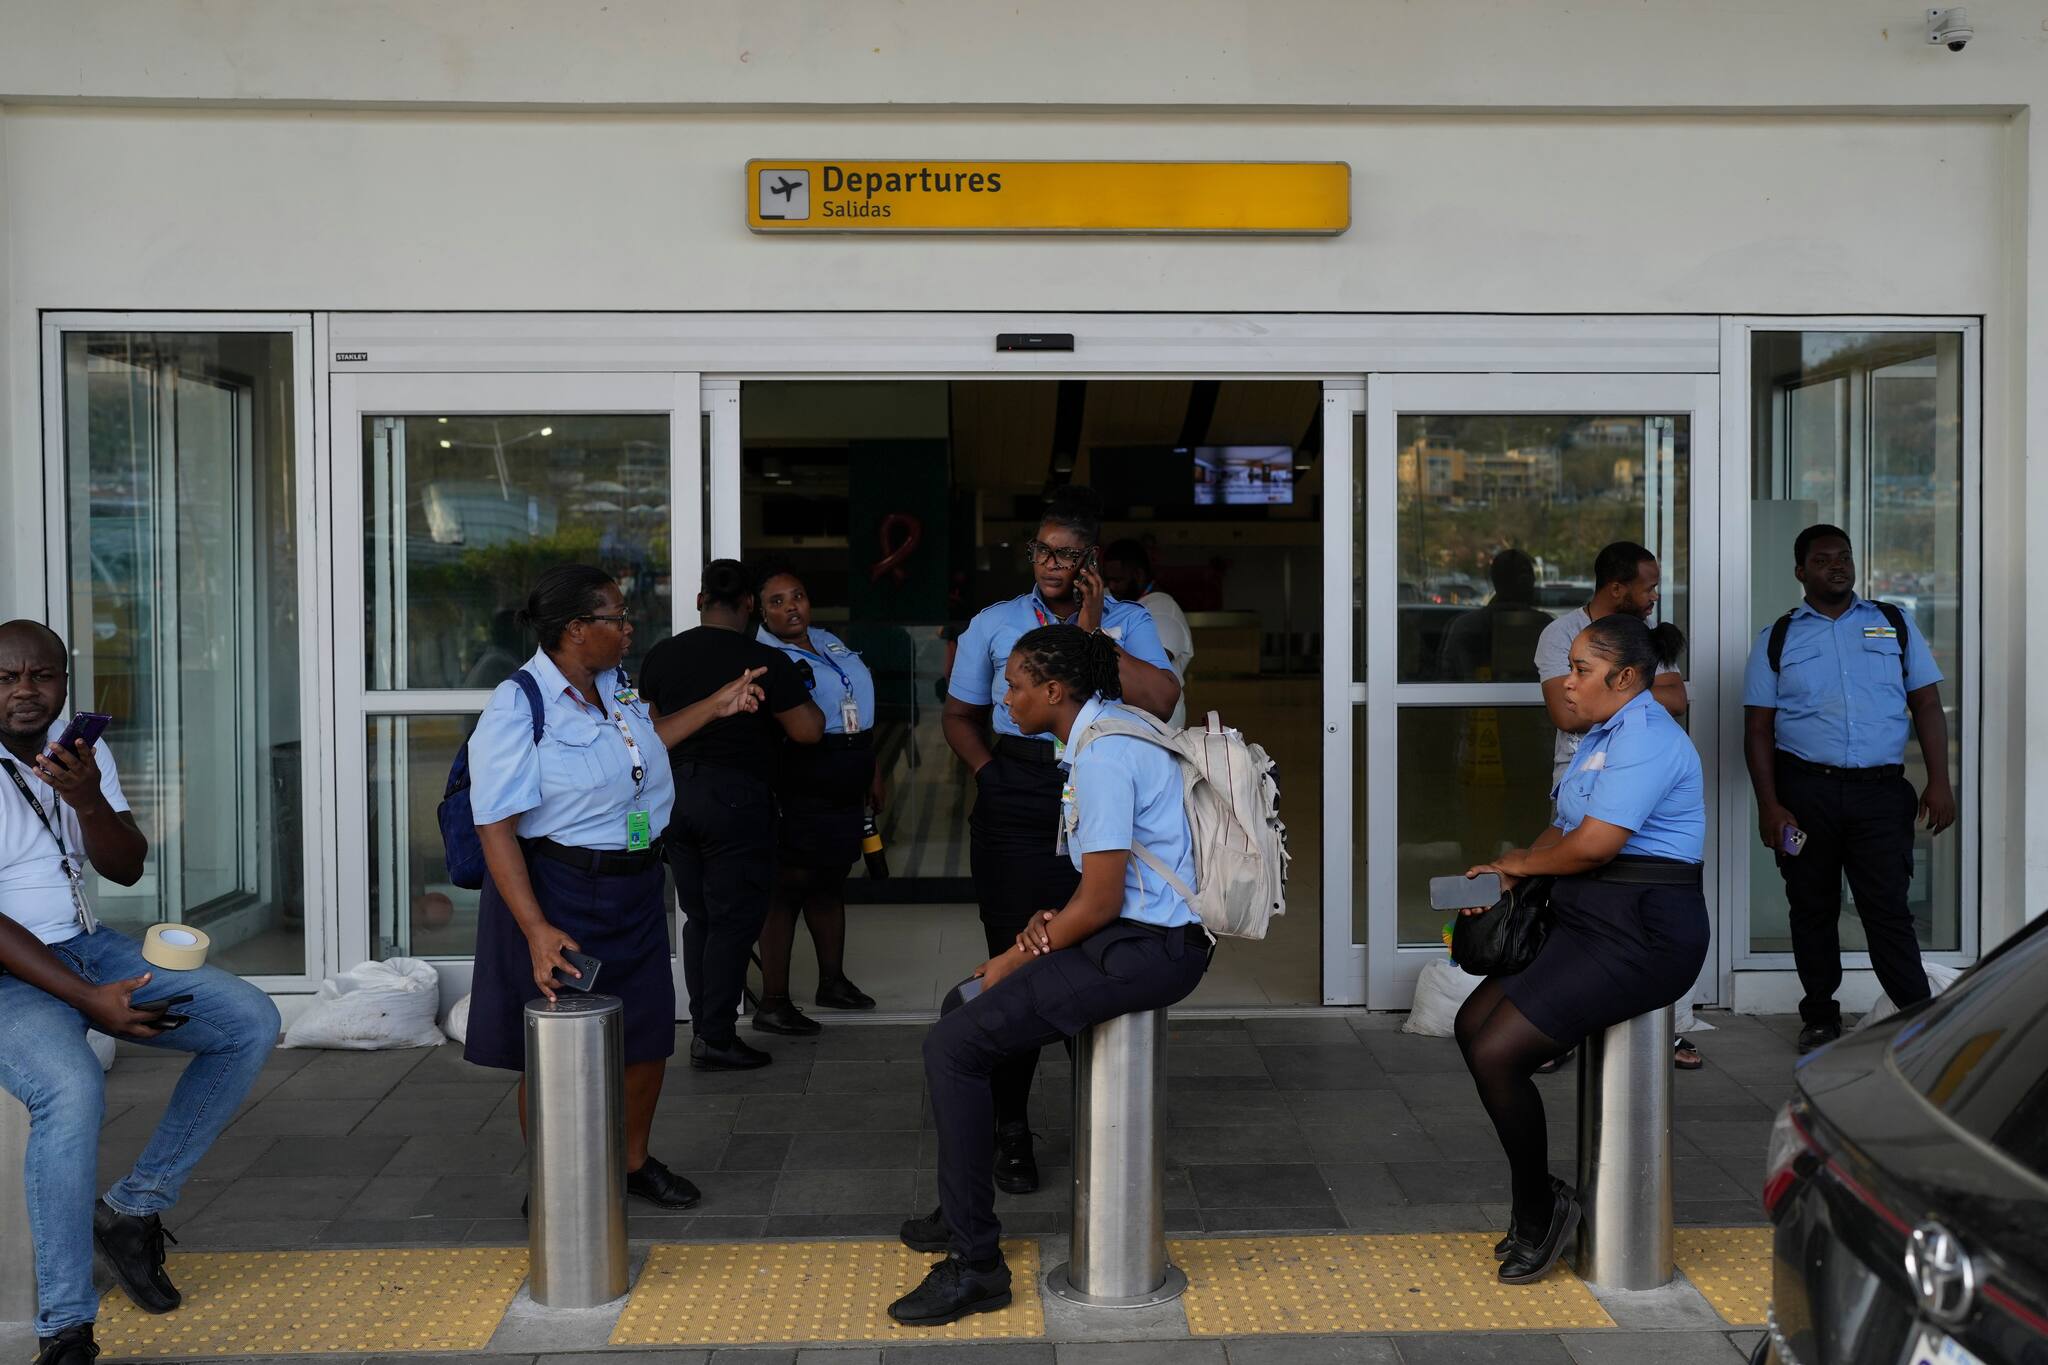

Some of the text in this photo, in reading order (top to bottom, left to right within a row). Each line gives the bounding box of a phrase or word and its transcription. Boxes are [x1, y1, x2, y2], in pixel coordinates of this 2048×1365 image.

[823, 166, 1002, 200] Departures
[823, 200, 892, 217] Salidas
[31, 799, 44, 816] SITA
